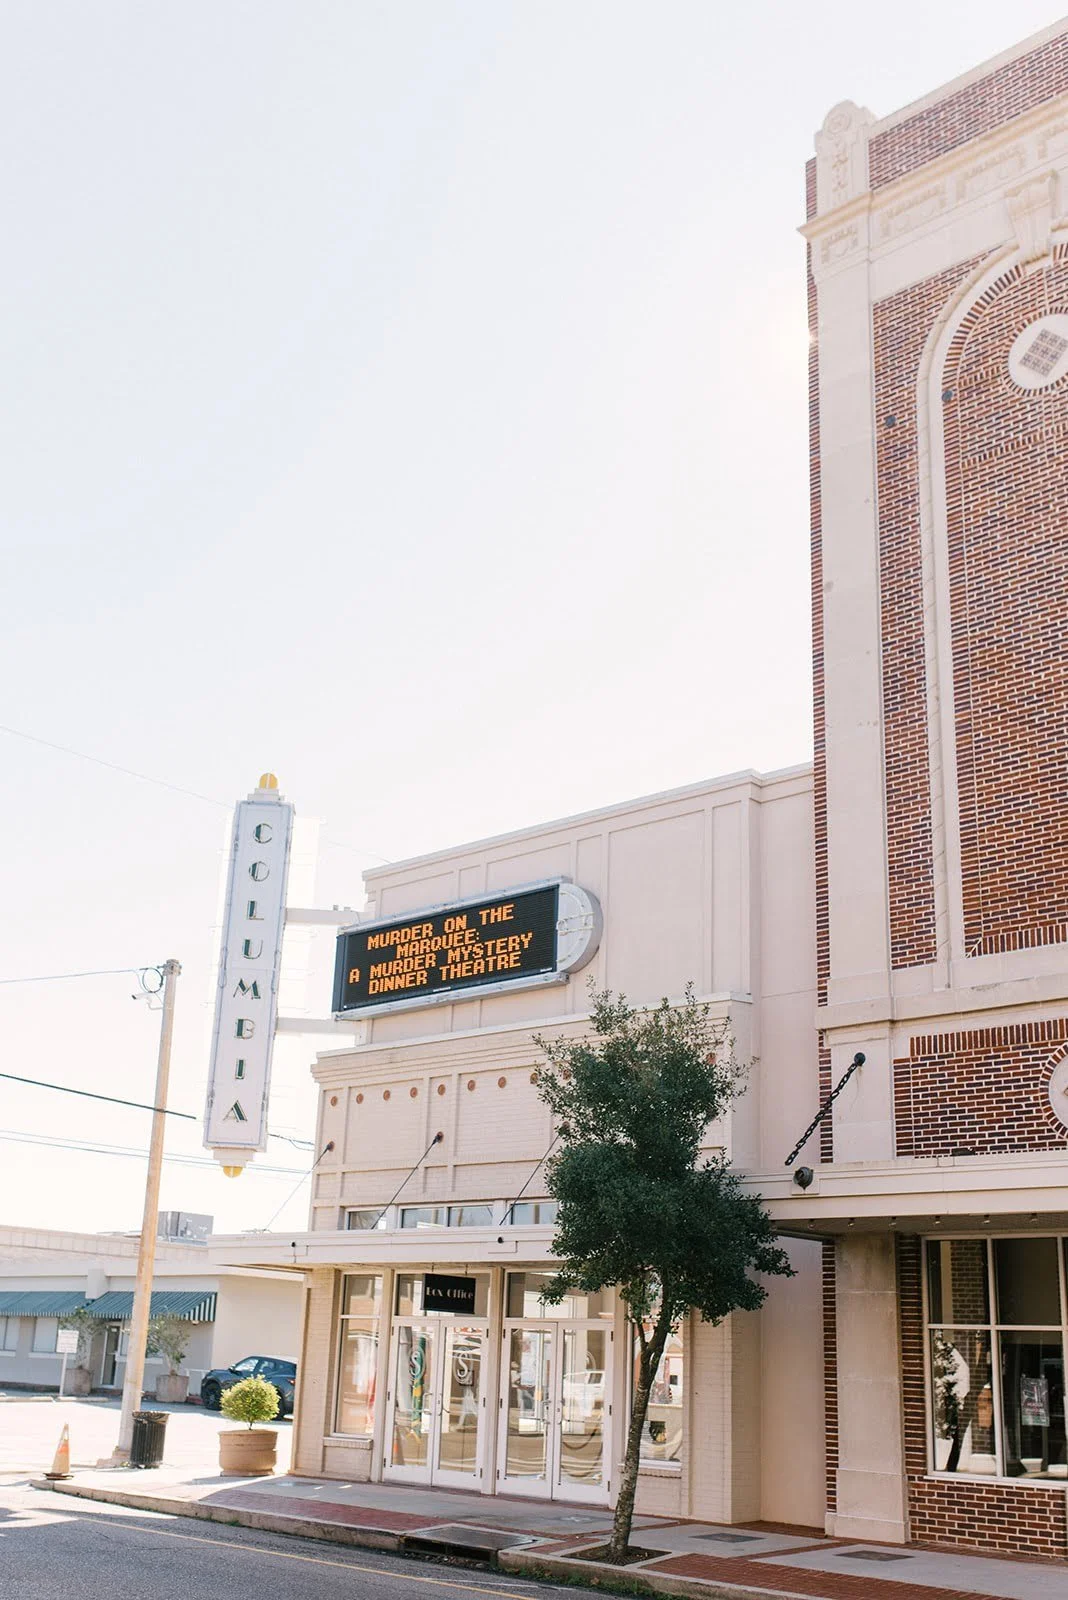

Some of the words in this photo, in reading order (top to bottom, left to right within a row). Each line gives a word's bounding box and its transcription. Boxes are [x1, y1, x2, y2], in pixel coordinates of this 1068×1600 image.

[367, 921, 433, 951] MURDER
[443, 914, 468, 933] ON
[479, 904, 515, 926] THE
[396, 928, 480, 959] MARQUEE:
[222, 821, 273, 1123] COLUMBIA
[348, 968, 361, 984] A
[370, 953, 436, 980] MURDER
[447, 932, 533, 965] MYSTERY
[368, 970, 428, 995] DINNER
[439, 951, 522, 981] THEATRE
[426, 1286, 443, 1297] Box
[446, 1288, 473, 1299] Office
